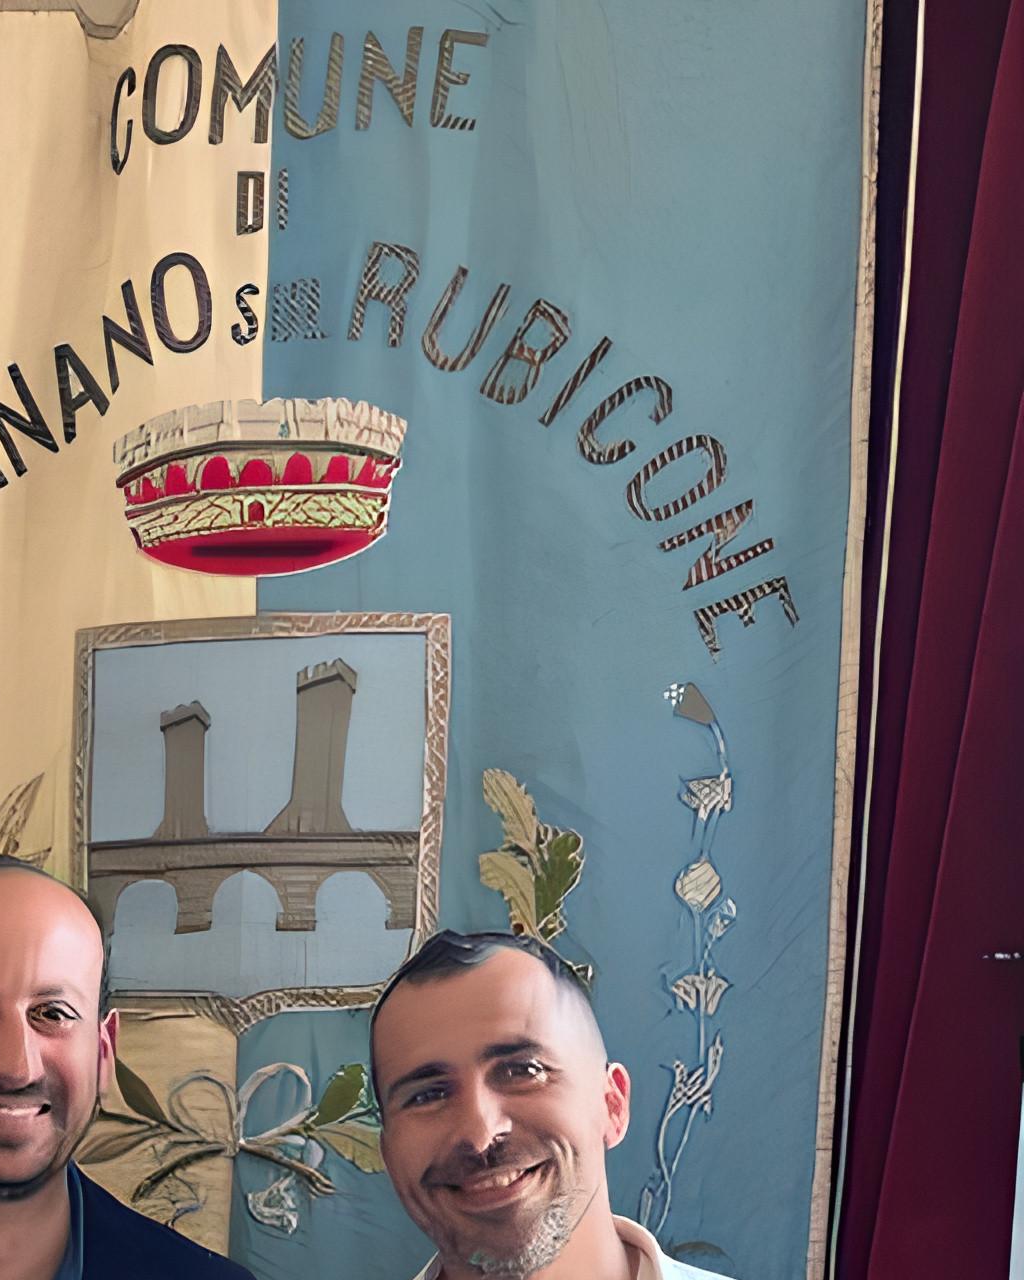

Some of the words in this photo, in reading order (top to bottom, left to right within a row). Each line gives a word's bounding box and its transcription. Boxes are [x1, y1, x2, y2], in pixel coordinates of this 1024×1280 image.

[110, 27, 489, 175] COMUNE
[236, 168, 289, 236] DI
[348, 242, 801, 665] RUBICONE
